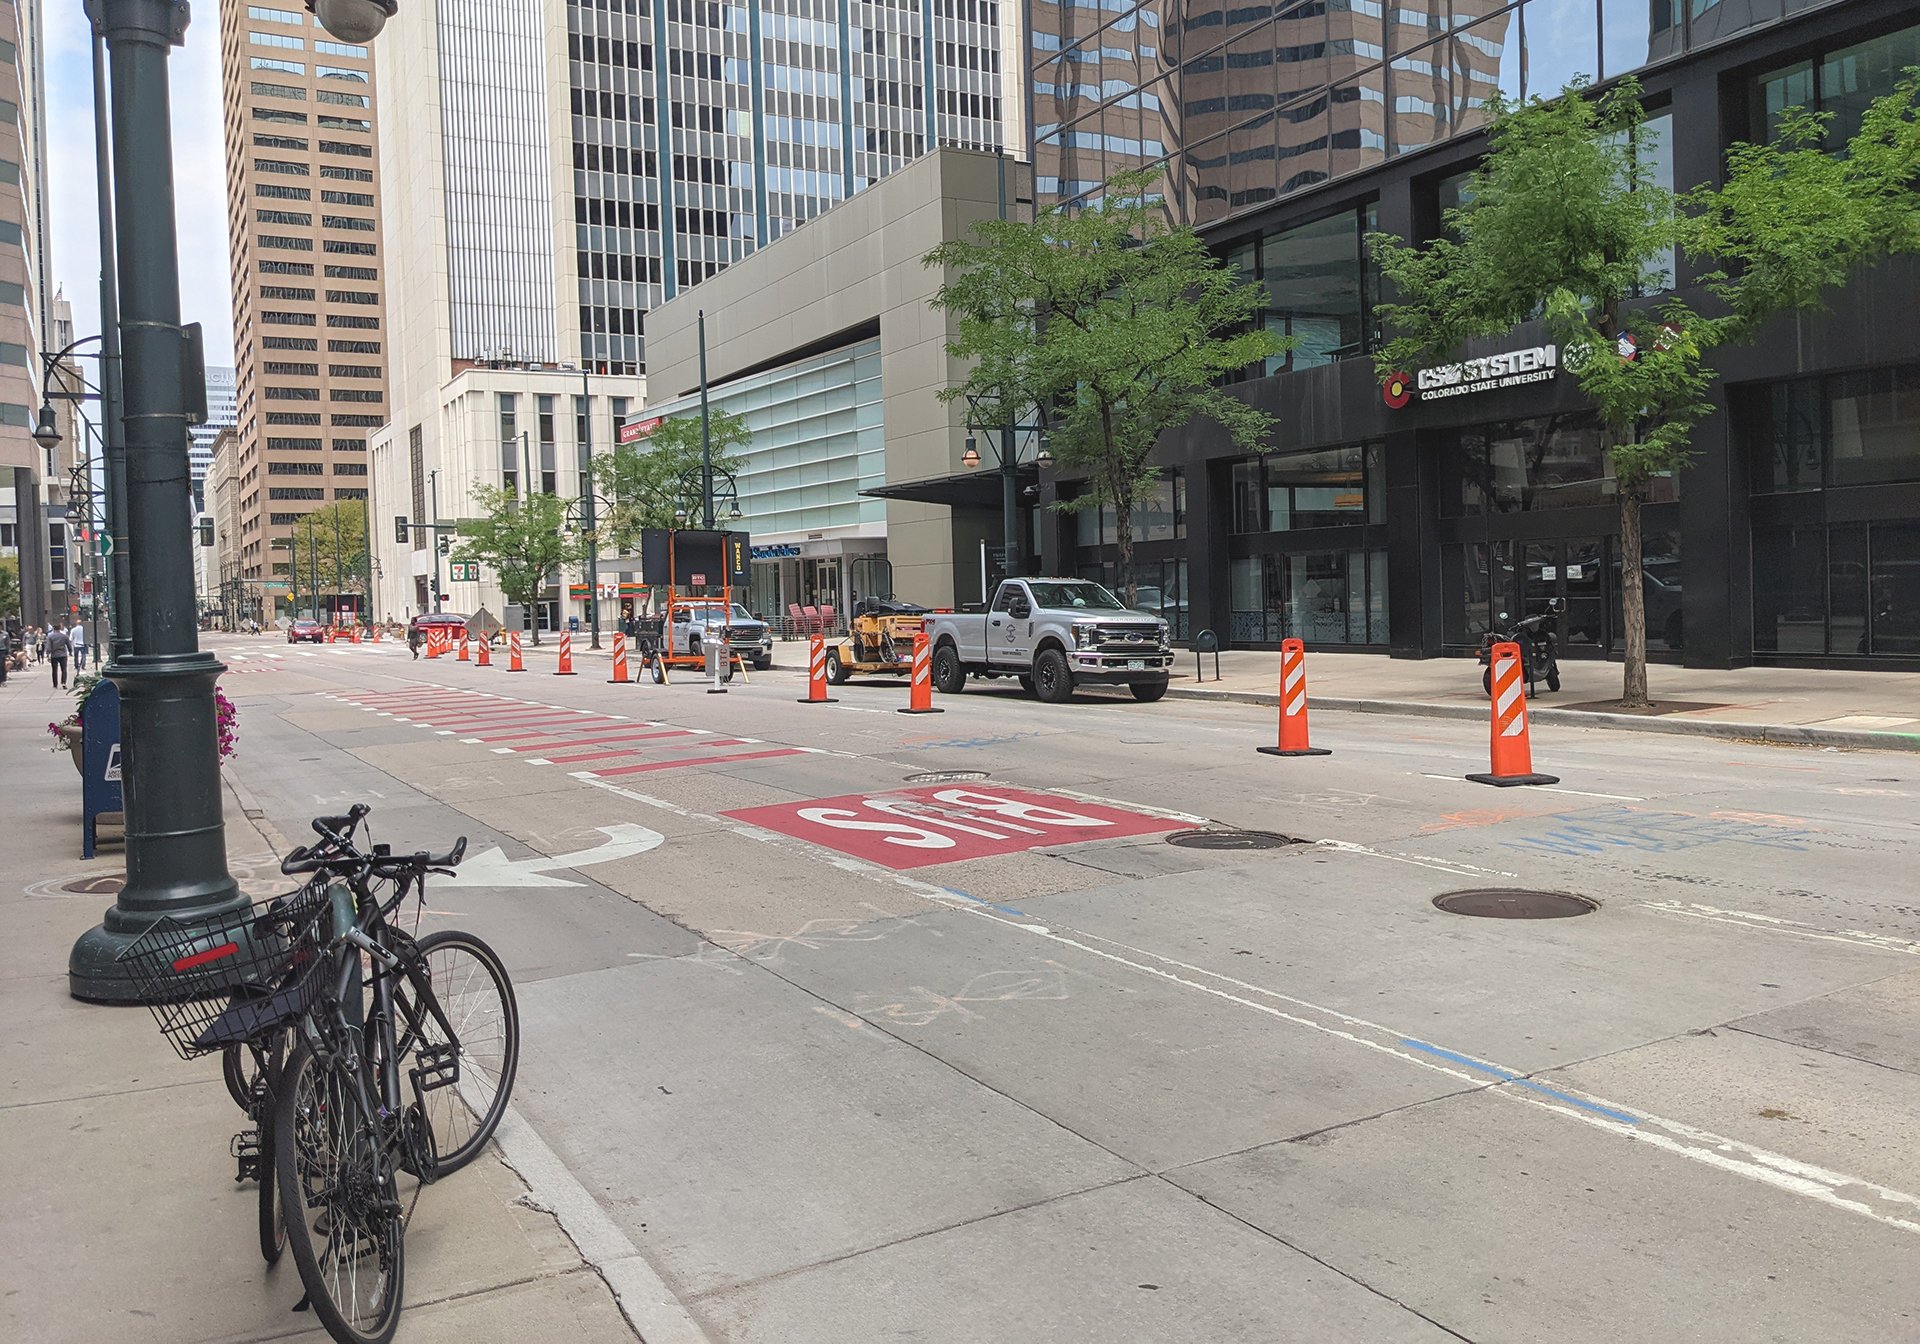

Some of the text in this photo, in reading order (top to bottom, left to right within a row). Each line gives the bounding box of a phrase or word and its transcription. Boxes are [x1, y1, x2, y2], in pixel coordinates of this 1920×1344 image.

[1463, 344, 1556, 381] SYSTEM
[1421, 369, 1555, 400] COLORADO STATE UNIVERSITY
[797, 788, 1117, 849] BUS
